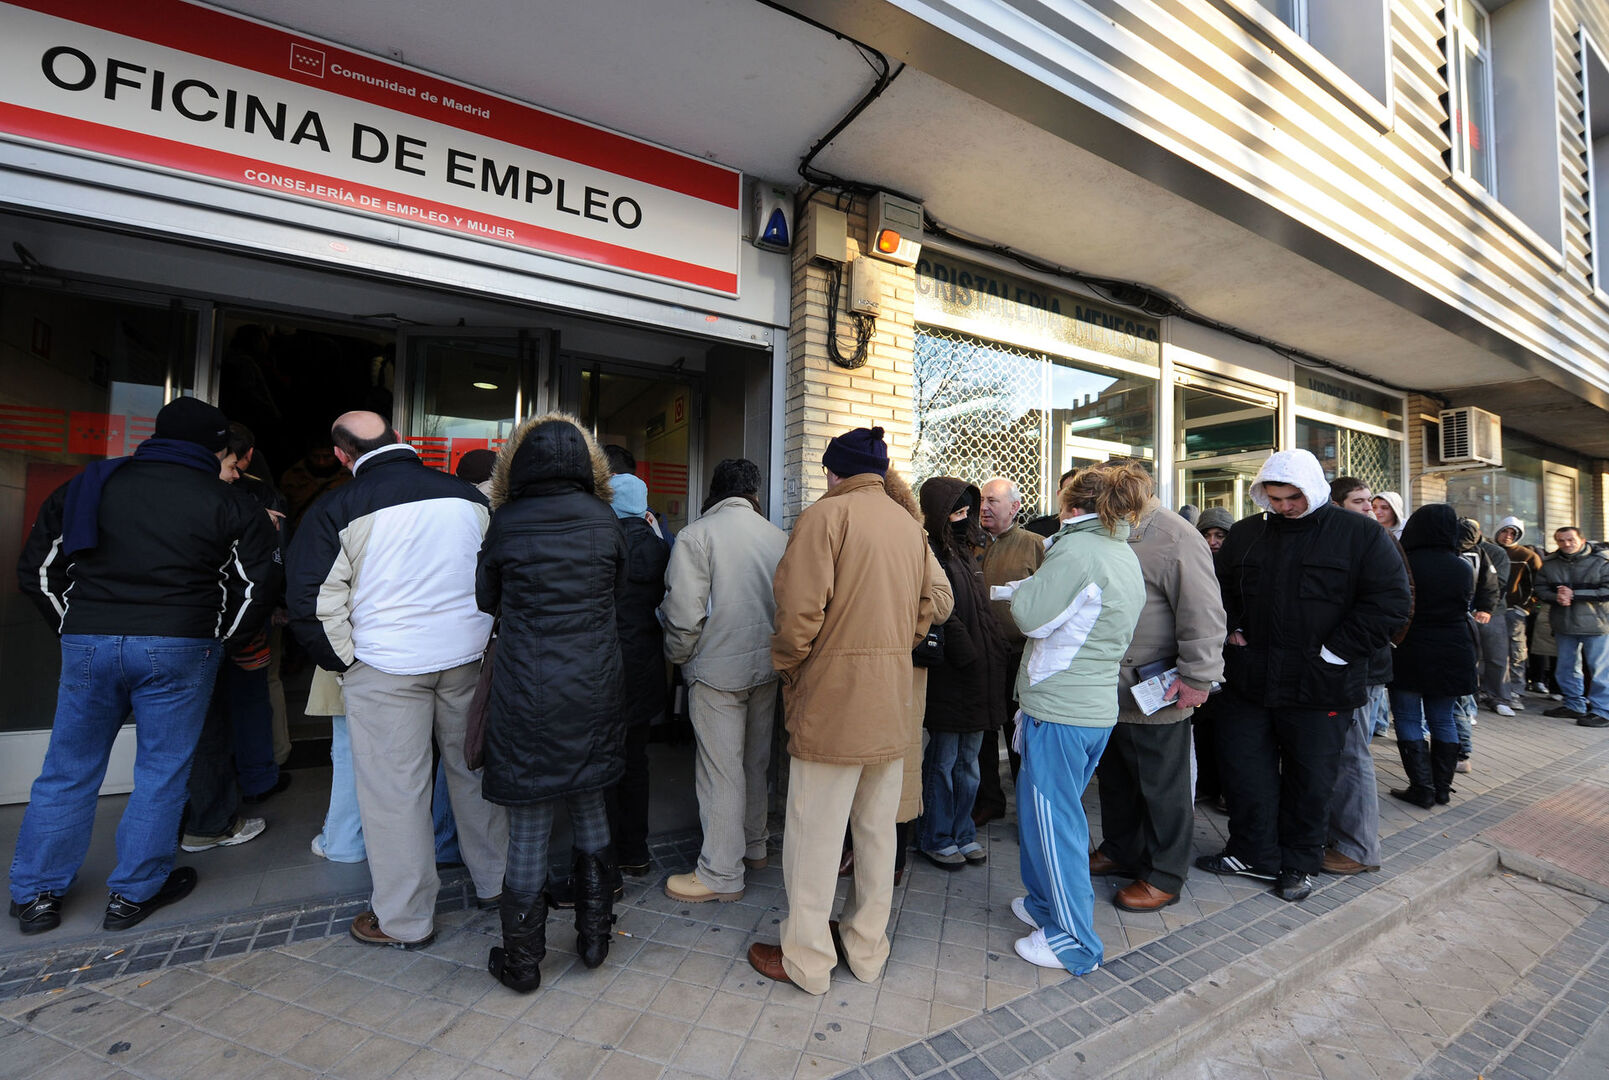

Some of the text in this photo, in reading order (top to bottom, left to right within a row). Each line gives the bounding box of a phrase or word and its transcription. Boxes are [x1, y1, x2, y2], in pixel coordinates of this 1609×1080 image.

[331, 63, 491, 119] Comunidad de Madrid
[42, 45, 642, 230] OFICINA DE EMPLEO
[244, 169, 515, 239] CONSEJERÍA DE EMPLEO Y MUJER
[914, 258, 1158, 359] CRISTALERIA MENESES
